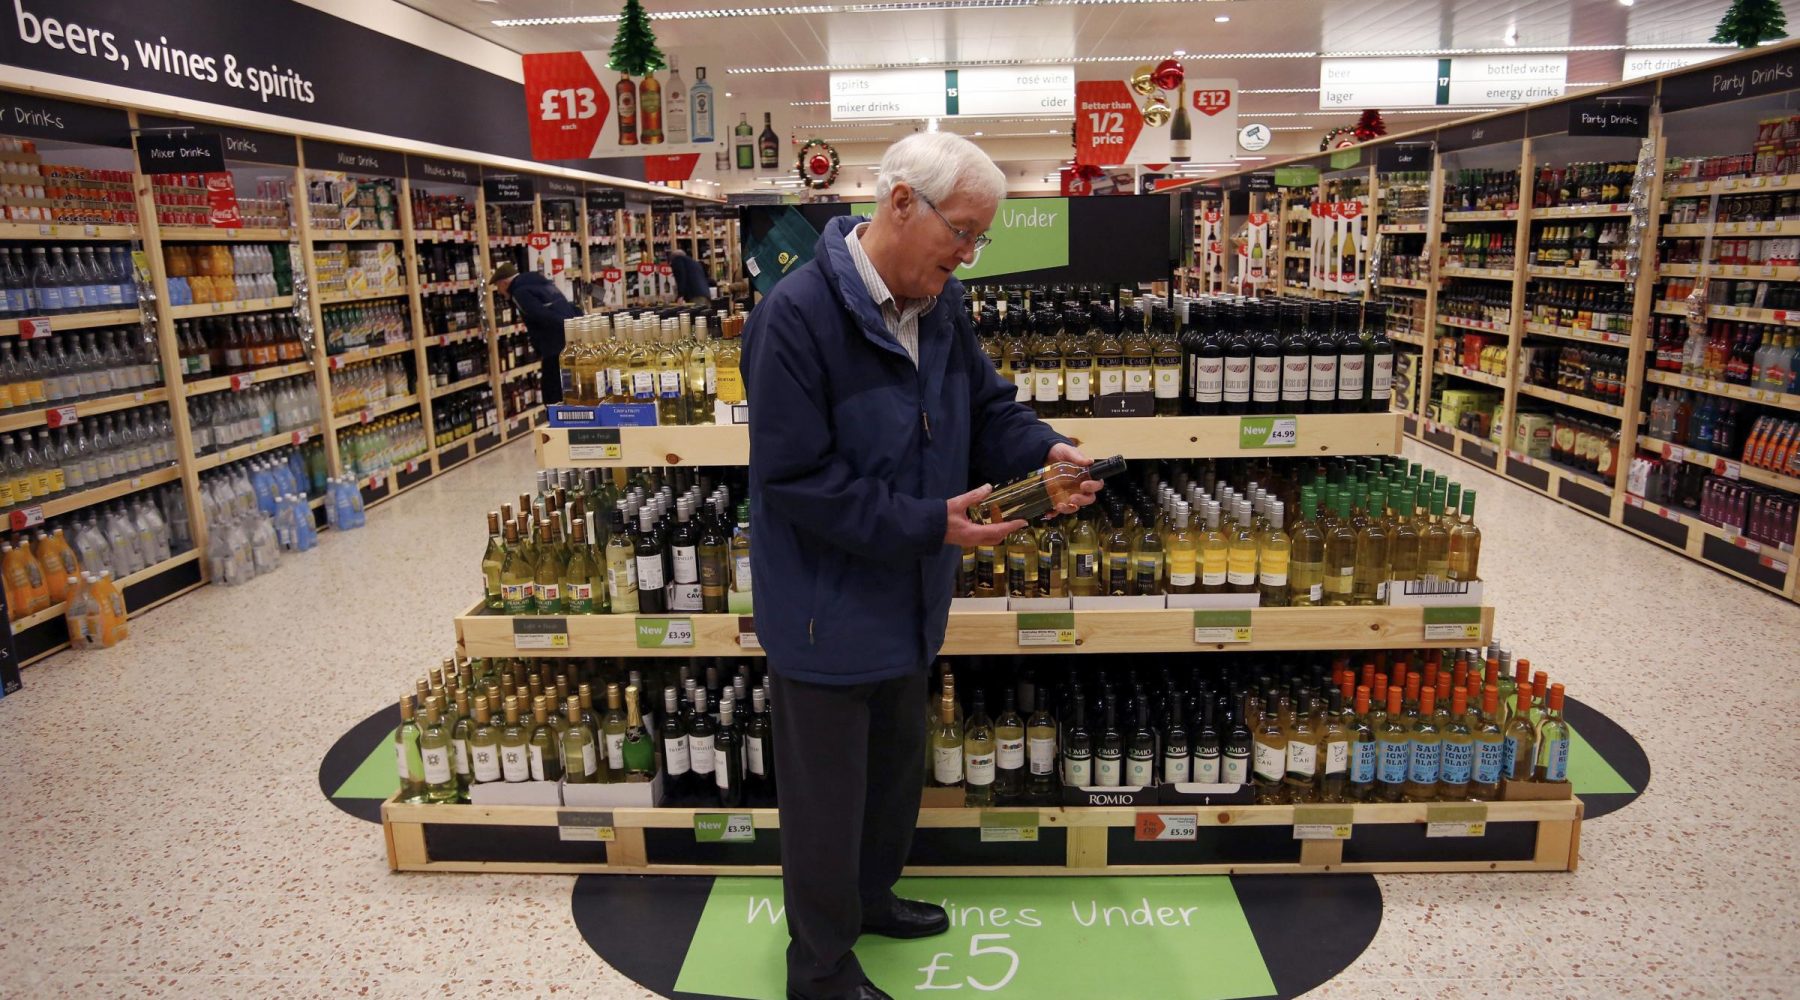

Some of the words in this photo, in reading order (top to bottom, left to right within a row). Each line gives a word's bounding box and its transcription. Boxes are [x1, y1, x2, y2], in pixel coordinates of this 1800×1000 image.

[13, 0, 131, 71] beers,
[135, 36, 218, 83] wines
[224, 54, 244, 88] &
[247, 64, 315, 104] spirits
[1487, 63, 1528, 75] bottled
[1529, 64, 1560, 74] water
[1631, 59, 1652, 71] soft
[1654, 58, 1688, 70] drinks
[1016, 73, 1042, 85] rosé
[1044, 73, 1068, 84] wine
[1327, 68, 1351, 79] beer
[836, 79, 870, 91] spirits
[1438, 77, 1449, 87] 17
[1712, 73, 1745, 96] Party
[1751, 64, 1793, 85] Drinks
[947, 88, 958, 97] 15
[1198, 90, 1226, 106] £12
[1326, 91, 1353, 104] lager
[1486, 88, 1524, 100] energy
[1526, 87, 1559, 97] drinks
[540, 87, 598, 120] £13
[837, 101, 866, 113] mixer
[868, 100, 900, 113] drinks
[1041, 96, 1068, 108] cider
[1081, 101, 1109, 111] Better
[1111, 100, 1132, 110] than
[15, 107, 64, 130] Drinks
[1089, 113, 1125, 133] 1/2
[1581, 113, 1606, 129] Party
[1610, 114, 1638, 125] Drinks
[227, 137, 257, 153] Drinks
[1092, 133, 1124, 148] price
[151, 147, 176, 158] Mixer
[180, 147, 210, 158] Drinks
[337, 152, 355, 165] Mixer
[357, 155, 378, 168] Drinks
[1344, 203, 1357, 212] 1/2
[1003, 207, 1058, 228] Under
[1244, 425, 1266, 435] New
[1272, 431, 1295, 439] £4.99
[639, 624, 663, 635] New
[668, 631, 691, 640] £3.99
[1482, 744, 1503, 752] SAU
[1089, 794, 1134, 806] ROMIO
[698, 821, 722, 830] New
[728, 825, 751, 833] £3.99
[1171, 828, 1194, 836] £5.99
[943, 898, 1041, 927] ines
[1072, 896, 1198, 928] Under
[914, 933, 1020, 991] £5
